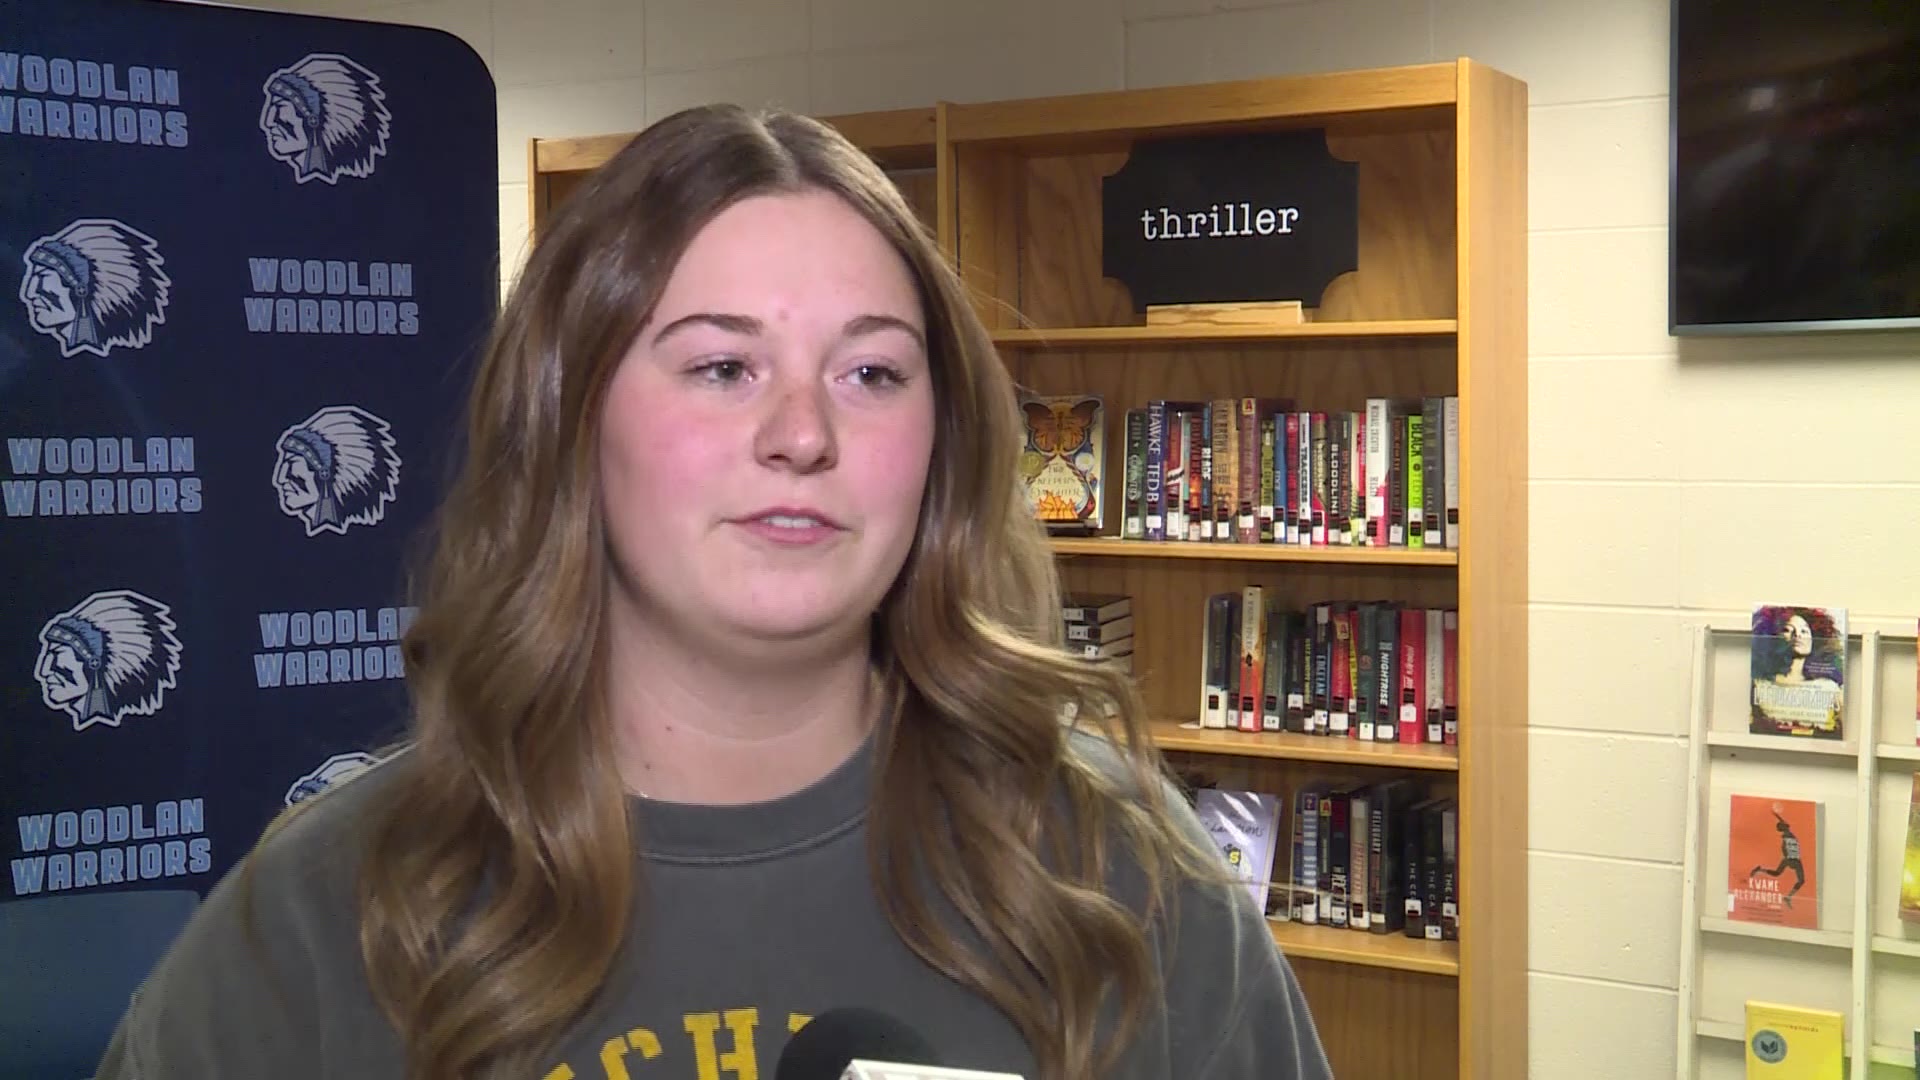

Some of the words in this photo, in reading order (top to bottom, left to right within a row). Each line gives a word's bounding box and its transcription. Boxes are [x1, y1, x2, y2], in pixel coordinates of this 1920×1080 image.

[0, 51, 181, 105] WOODLAN
[0, 96, 189, 148] WARRIORS
[1141, 202, 1299, 240] thriller
[248, 257, 413, 296] WOODLAN
[243, 297, 420, 336] WARRIORS
[1148, 405, 1162, 455] HAWKE
[1411, 423, 1423, 457] BLACK
[7, 436, 196, 475] WOODLAN
[1, 477, 203, 517] WARRIORS
[1379, 652, 1389, 706] NIGHTRISE
[18, 797, 205, 851] WOODLAN
[1371, 810, 1382, 853] RELIQUARY
[11, 838, 213, 896] WARRIORS
[1748, 878, 1780, 892] KWAME
[1733, 888, 1783, 904] ALEXANDER
